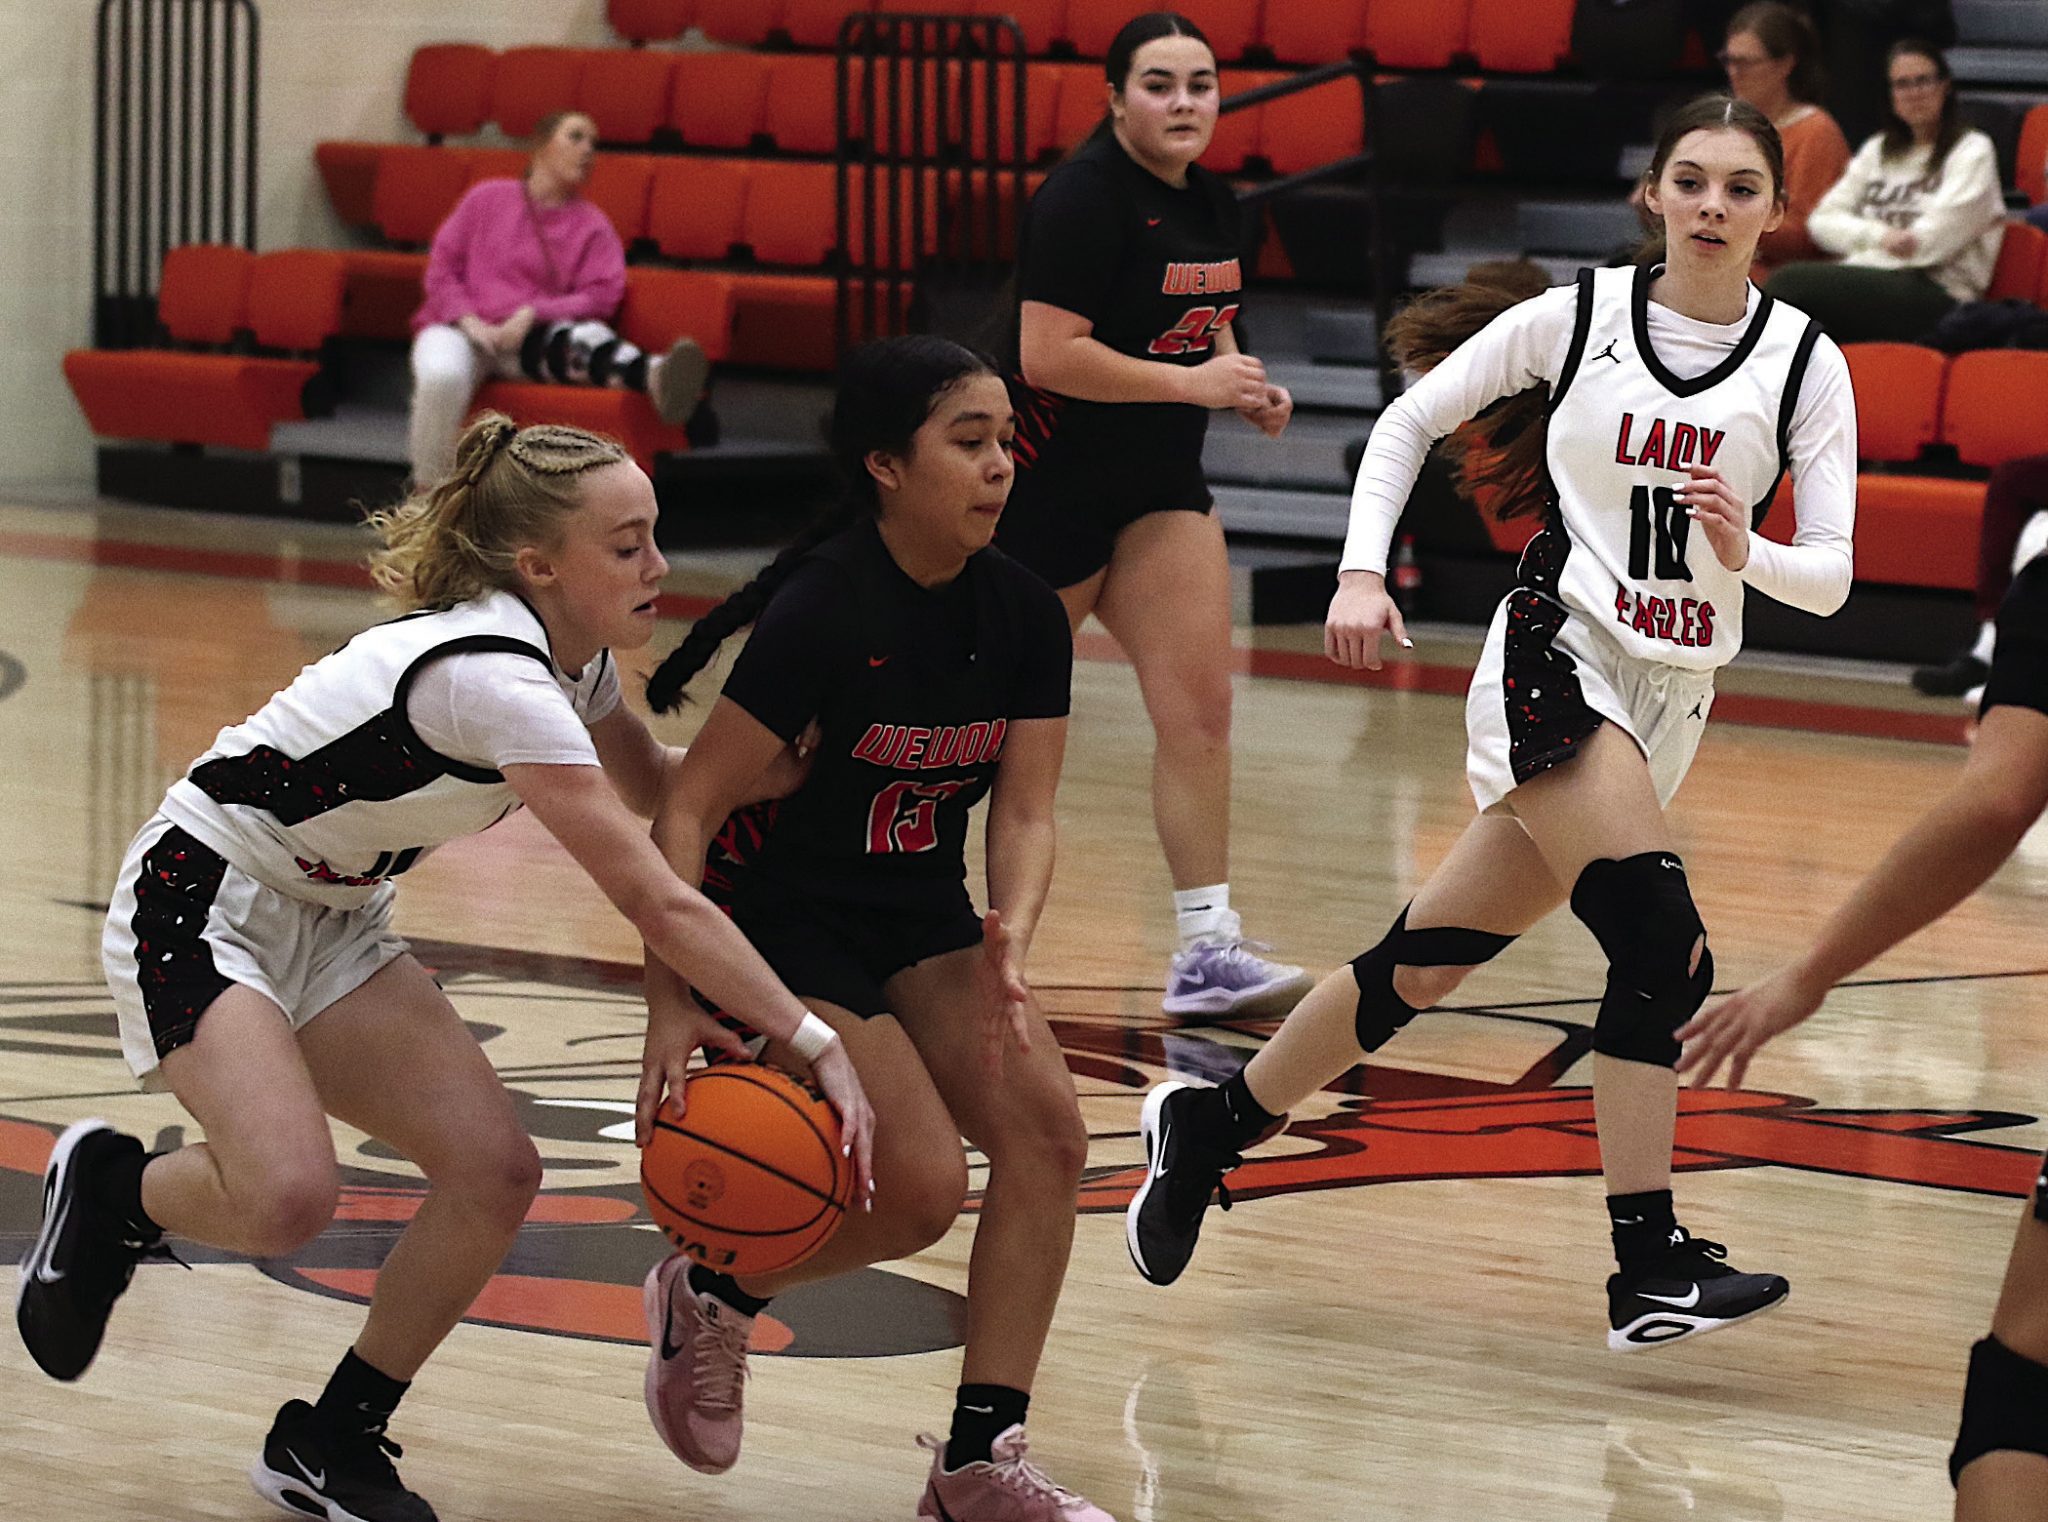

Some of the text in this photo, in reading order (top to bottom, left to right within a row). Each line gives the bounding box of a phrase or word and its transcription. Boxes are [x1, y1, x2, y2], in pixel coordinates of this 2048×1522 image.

[1615, 412, 1726, 473] LADY
[1628, 485, 1694, 583] 10
[1614, 580, 1716, 647] EAGLES
